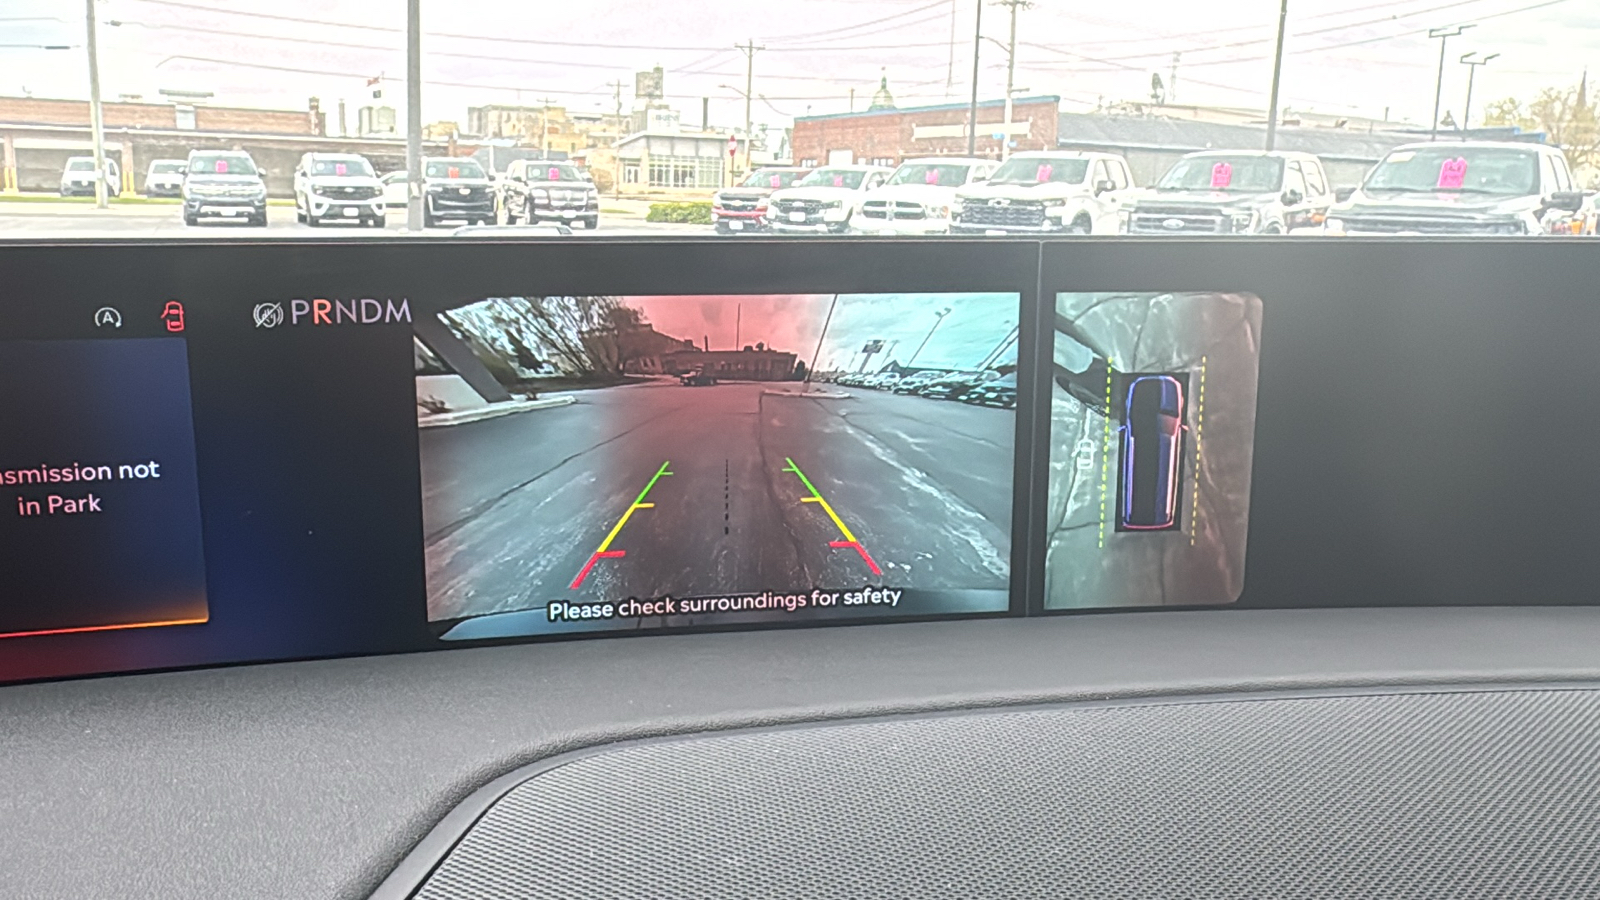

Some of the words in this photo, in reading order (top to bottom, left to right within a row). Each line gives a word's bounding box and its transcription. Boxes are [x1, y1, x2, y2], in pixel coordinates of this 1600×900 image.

[102, 311, 114, 324] A
[118, 460, 161, 480] not
[17, 496, 41, 516] in
[47, 493, 102, 514] Park
[549, 602, 614, 621] Please
[618, 597, 676, 617] check
[680, 591, 807, 612] surroundings
[811, 590, 840, 607] for
[843, 587, 902, 607] safety
